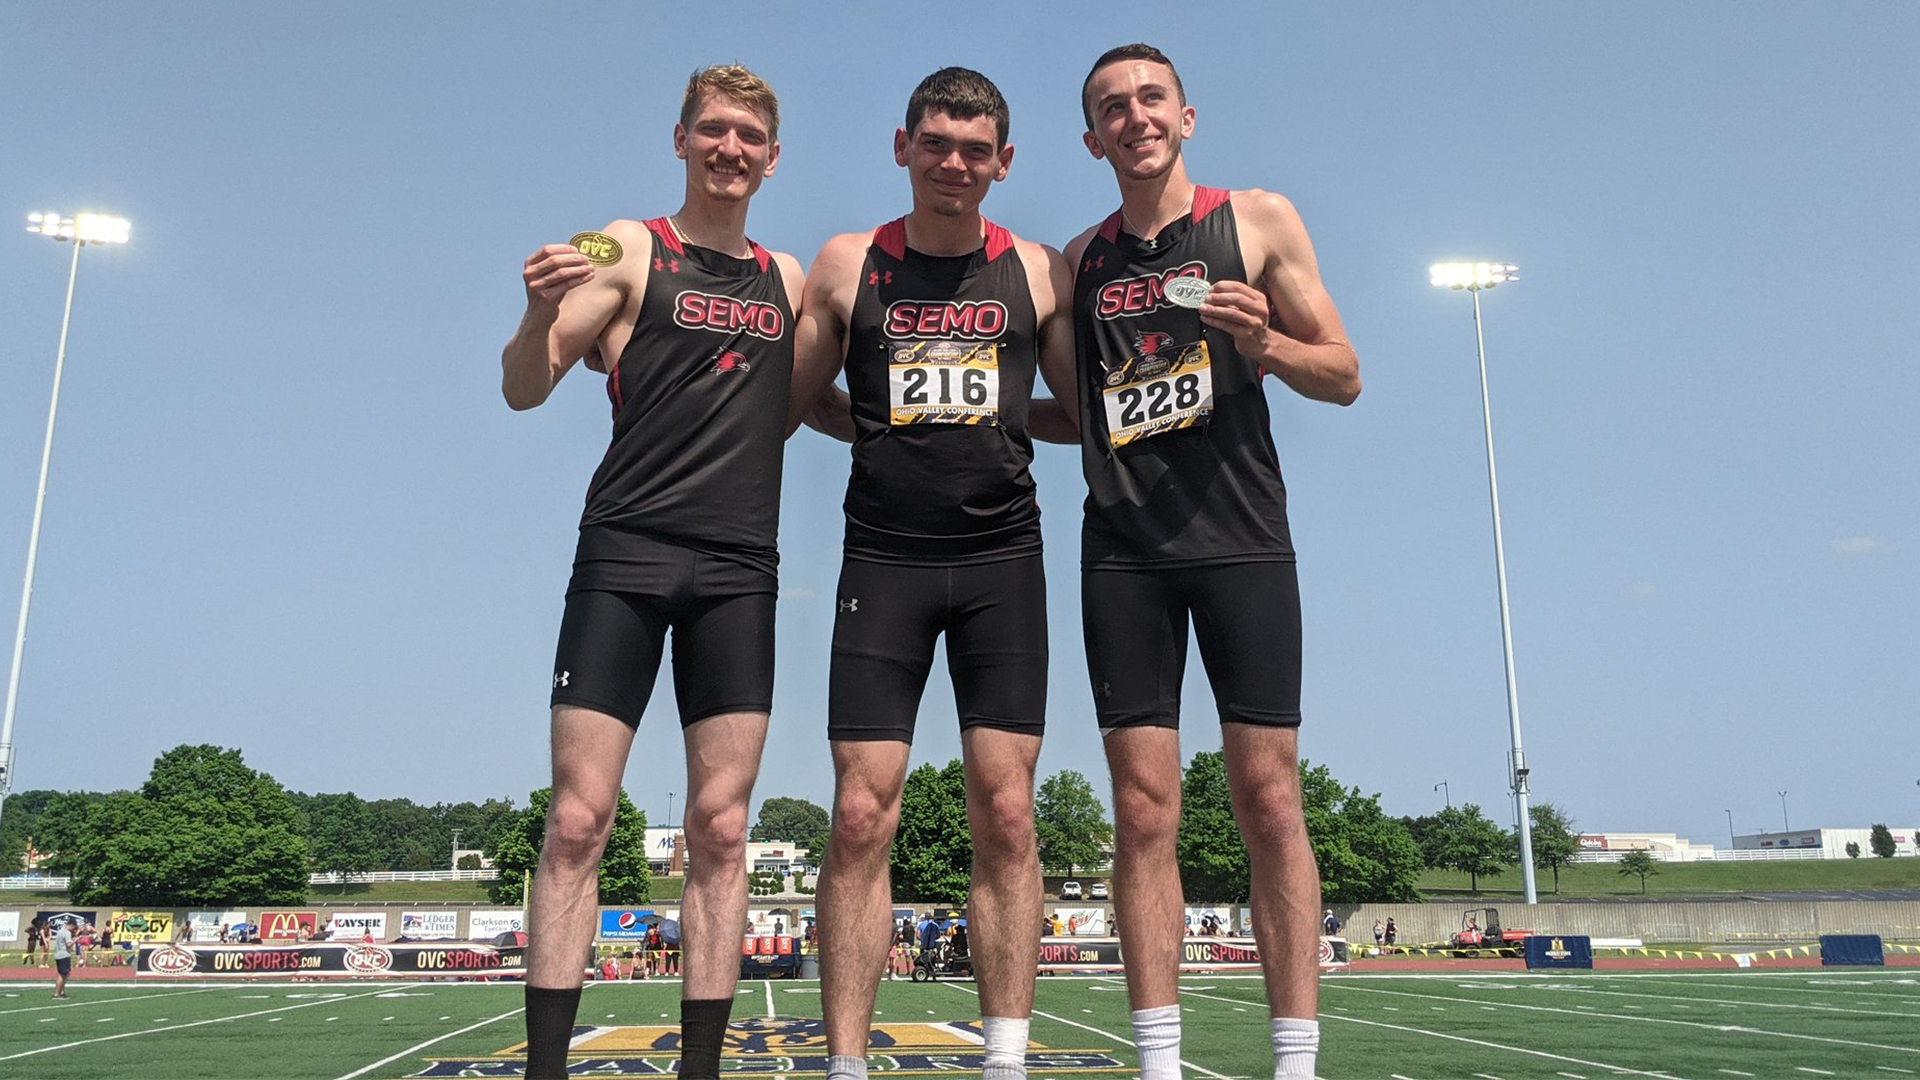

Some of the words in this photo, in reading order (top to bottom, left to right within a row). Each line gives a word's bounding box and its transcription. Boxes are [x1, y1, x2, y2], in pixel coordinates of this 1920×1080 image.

[580, 240, 612, 258] OVC
[677, 292, 783, 338] SEMO
[887, 303, 1005, 335] SEMO
[903, 368, 987, 406] 216
[1117, 373, 1200, 428] 228
[896, 407, 916, 416] OHIO
[917, 406, 945, 414] VALLEY
[946, 406, 994, 417] CONFERENCE
[1115, 428, 1134, 440] OHIO
[1136, 421, 1161, 433] VALLEY
[1161, 408, 1209, 425] CONFERENCE
[114, 919, 169, 933] FRGY
[334, 918, 382, 928] KAYSER
[423, 914, 455, 923] LEDGER
[471, 917, 508, 926] Clarkson
[158, 954, 186, 966] OVC
[214, 951, 321, 970] OVCSPORTS.COM
[1038, 944, 1099, 962] PORTS.COM
